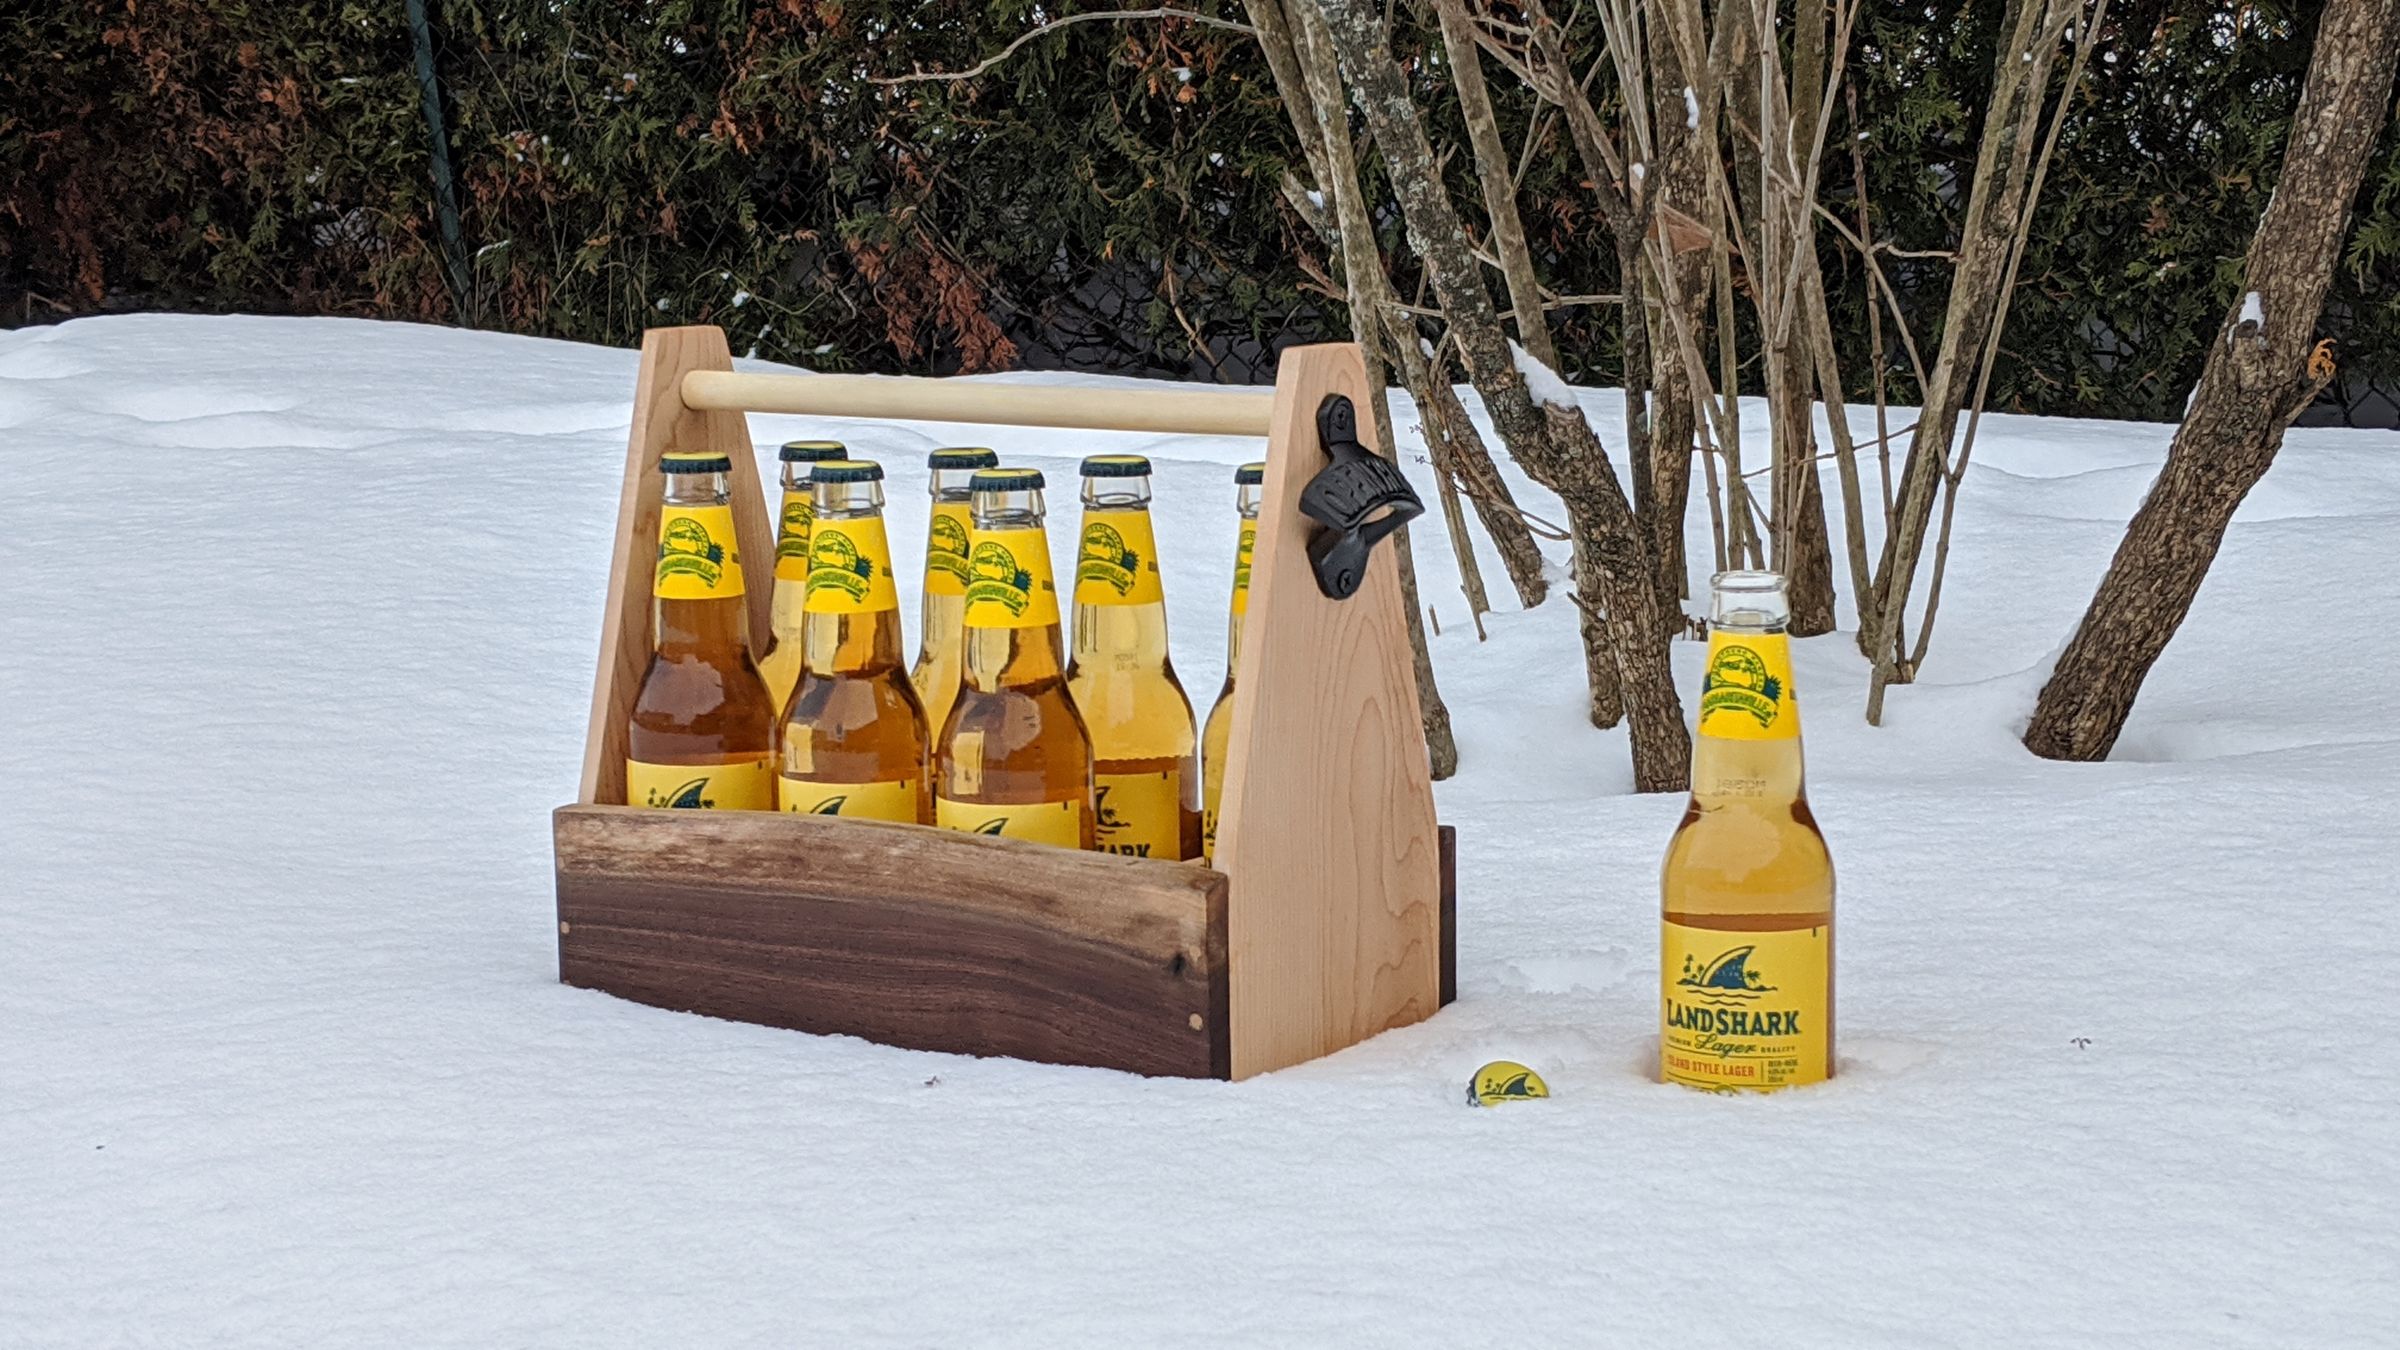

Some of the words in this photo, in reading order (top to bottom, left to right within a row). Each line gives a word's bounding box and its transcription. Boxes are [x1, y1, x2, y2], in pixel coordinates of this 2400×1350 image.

[1667, 998, 1800, 1036] LANDSHARK
[1694, 1033, 1757, 1059] Lager
[1692, 1060, 1720, 1075] STYLE
[1722, 1064, 1755, 1077] LAGER
